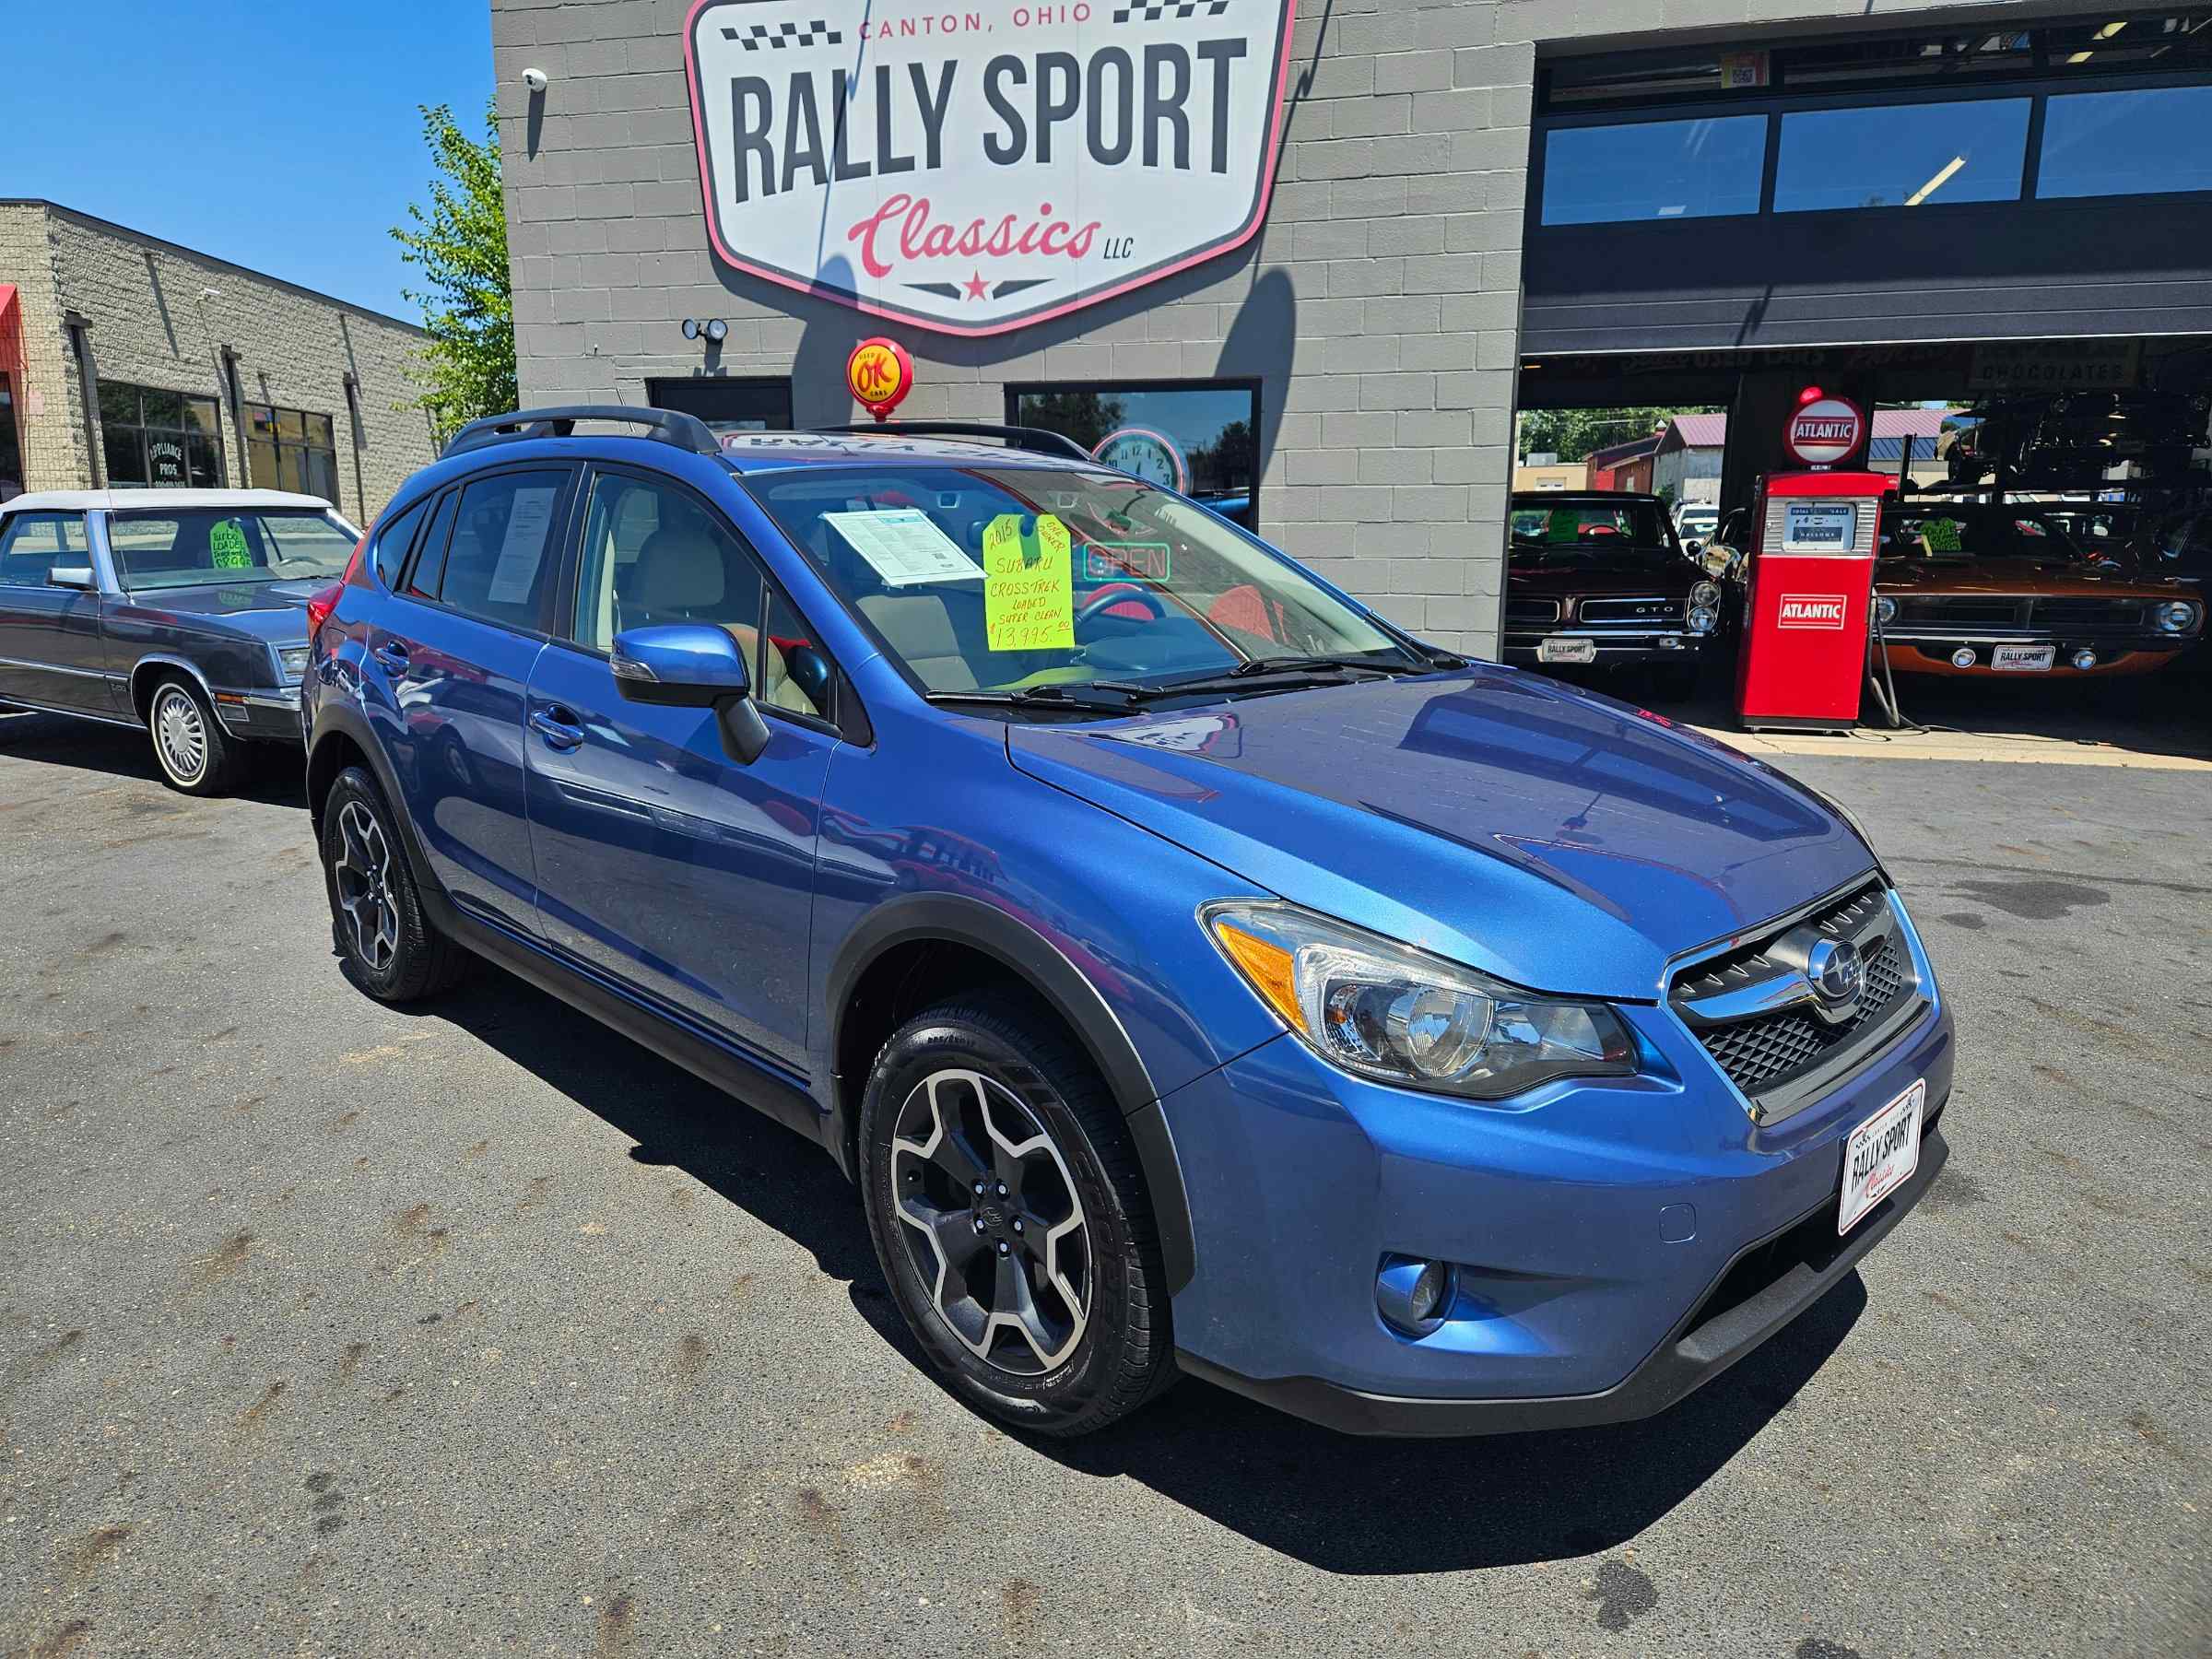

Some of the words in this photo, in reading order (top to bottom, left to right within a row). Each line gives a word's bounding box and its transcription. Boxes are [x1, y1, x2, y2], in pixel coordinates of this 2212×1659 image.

[858, 12, 994, 41] CANTON,
[1013, 3, 1091, 27] OHIO
[731, 59, 959, 204] RALLY
[982, 37, 1247, 175] SPORT
[848, 194, 1101, 278] Classics
[1103, 236, 1135, 260] LLC
[857, 352, 893, 393] OK
[1982, 362, 2124, 381] CHOCOLATES
[1795, 422, 1853, 439] ATLANTIC
[159, 463, 178, 476] PROS
[1037, 525, 1066, 553] OWNER
[1046, 522, 1061, 538] ONE
[995, 556, 1053, 574] SUBARU
[1088, 547, 1166, 576] OPEN
[1012, 596, 1046, 610] LOADED
[1636, 606, 1674, 614] GTO
[1782, 603, 1841, 619] ATLANTIC
[999, 611, 1029, 625] SUPER
[1034, 607, 1062, 622] CLEAN
[1547, 645, 1566, 654] RALLY
[1567, 645, 1586, 654] SPORT
[2001, 652, 2021, 662] RALLY
[2021, 652, 2046, 662] SPORT
[1851, 1136, 1883, 1193] RALLY
[1883, 1112, 1913, 1159] SPORT
